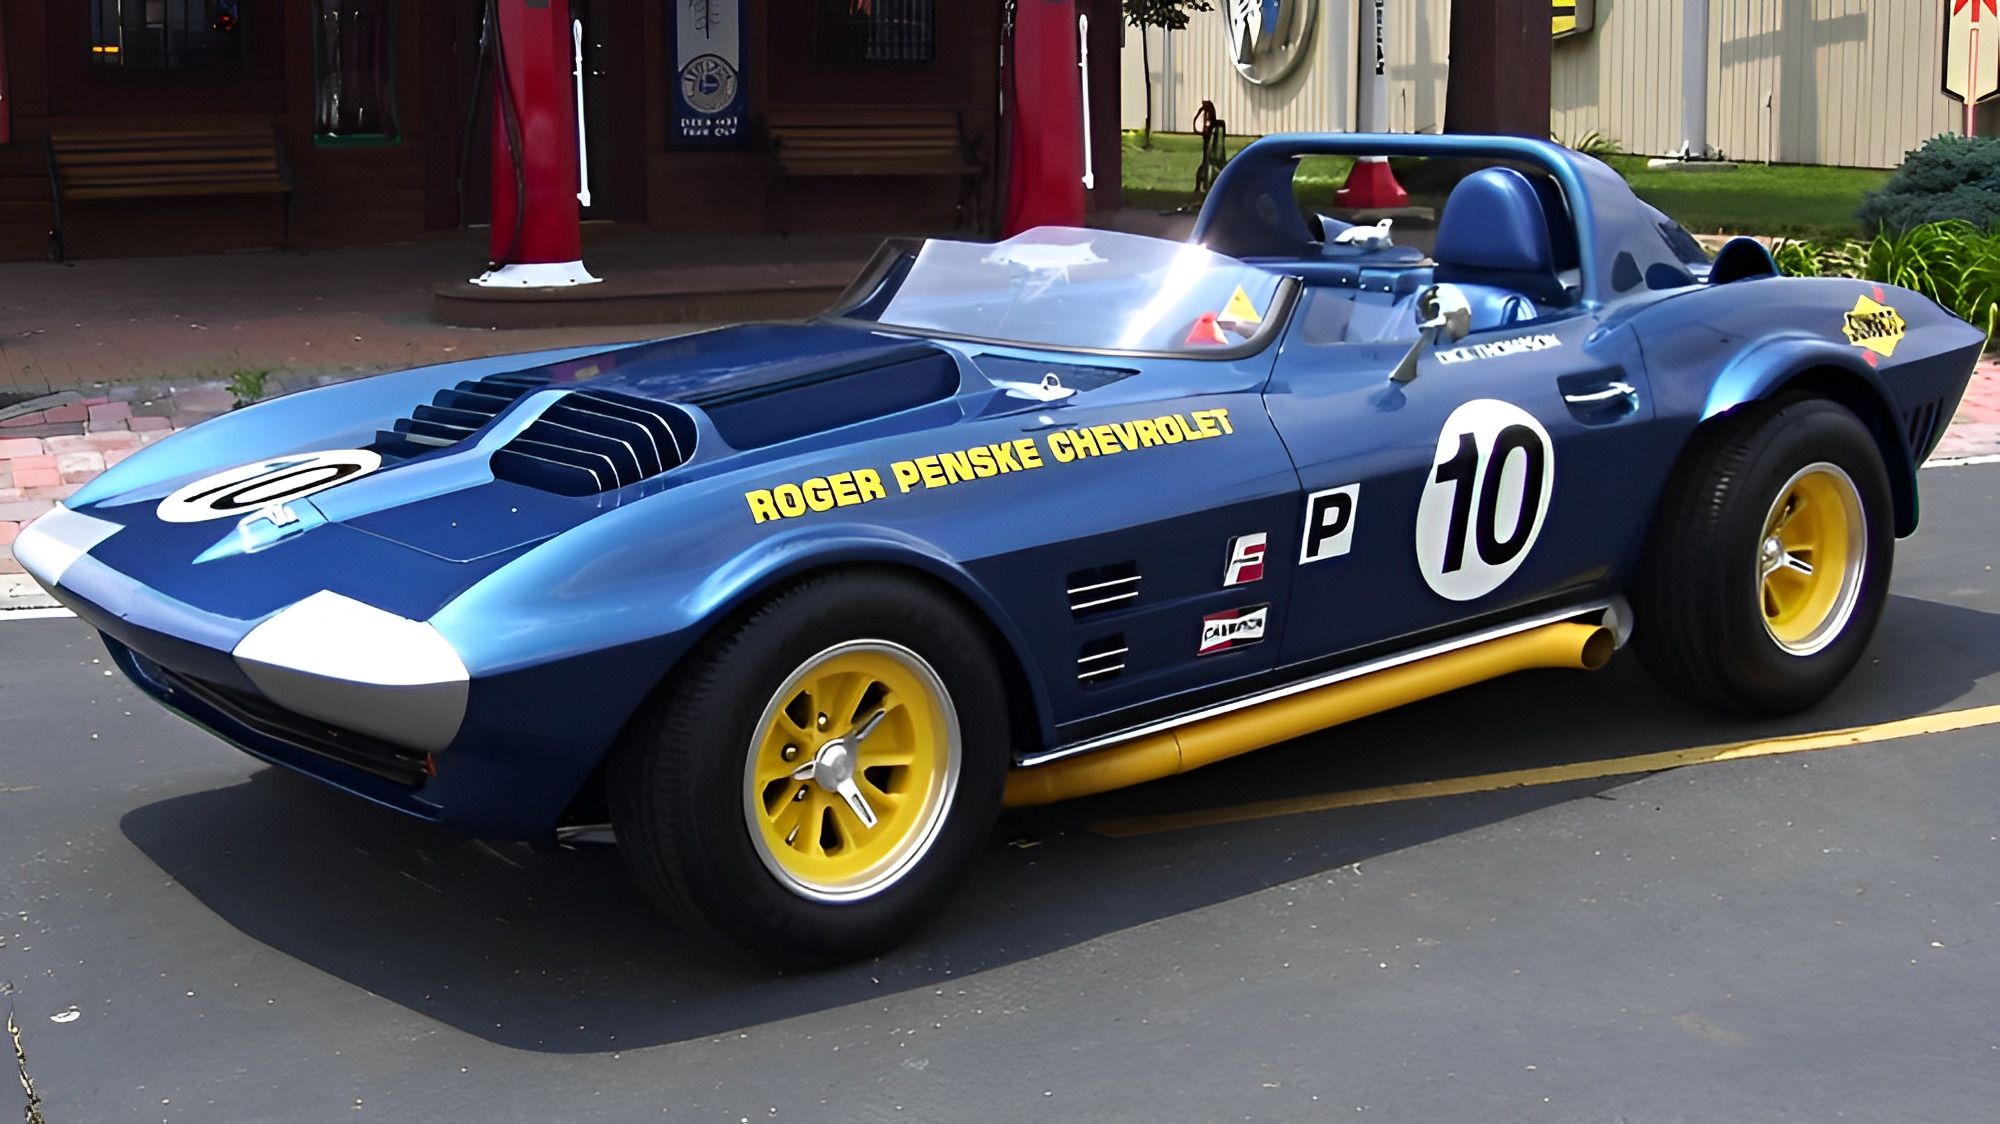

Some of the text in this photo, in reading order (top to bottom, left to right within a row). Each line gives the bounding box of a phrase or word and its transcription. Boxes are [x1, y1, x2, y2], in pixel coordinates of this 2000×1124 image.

[183, 457, 362, 510] 10
[745, 408, 1234, 523] ROGER PENSKE CHEVROLET
[1435, 424, 1545, 575] 10
[1306, 492, 1353, 559] P
